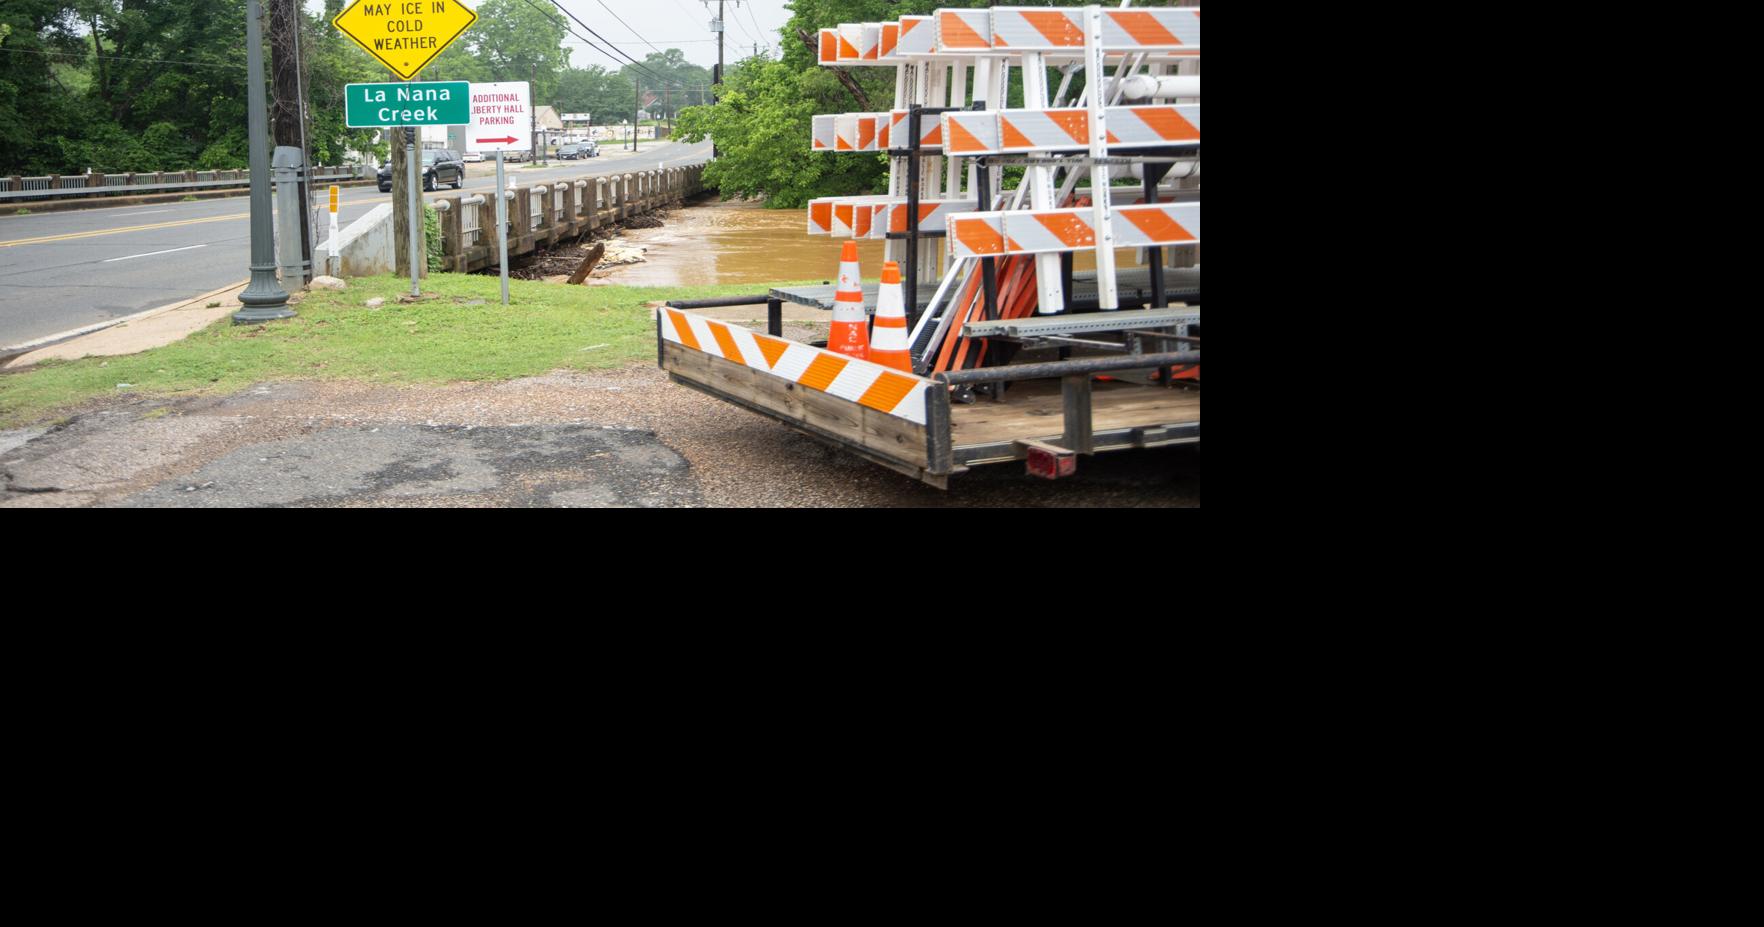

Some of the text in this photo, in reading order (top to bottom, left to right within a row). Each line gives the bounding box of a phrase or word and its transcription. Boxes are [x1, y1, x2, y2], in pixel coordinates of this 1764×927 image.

[364, 2, 445, 16] MAY ICE IN
[387, 20, 423, 32] COLD
[374, 37, 437, 50] WEATHER
[364, 88, 450, 103] La Nana
[472, 93, 519, 103] ADDITIONAL
[378, 106, 438, 122] Creek
[504, 104, 524, 113] HALL
[479, 116, 514, 126] PARKING
